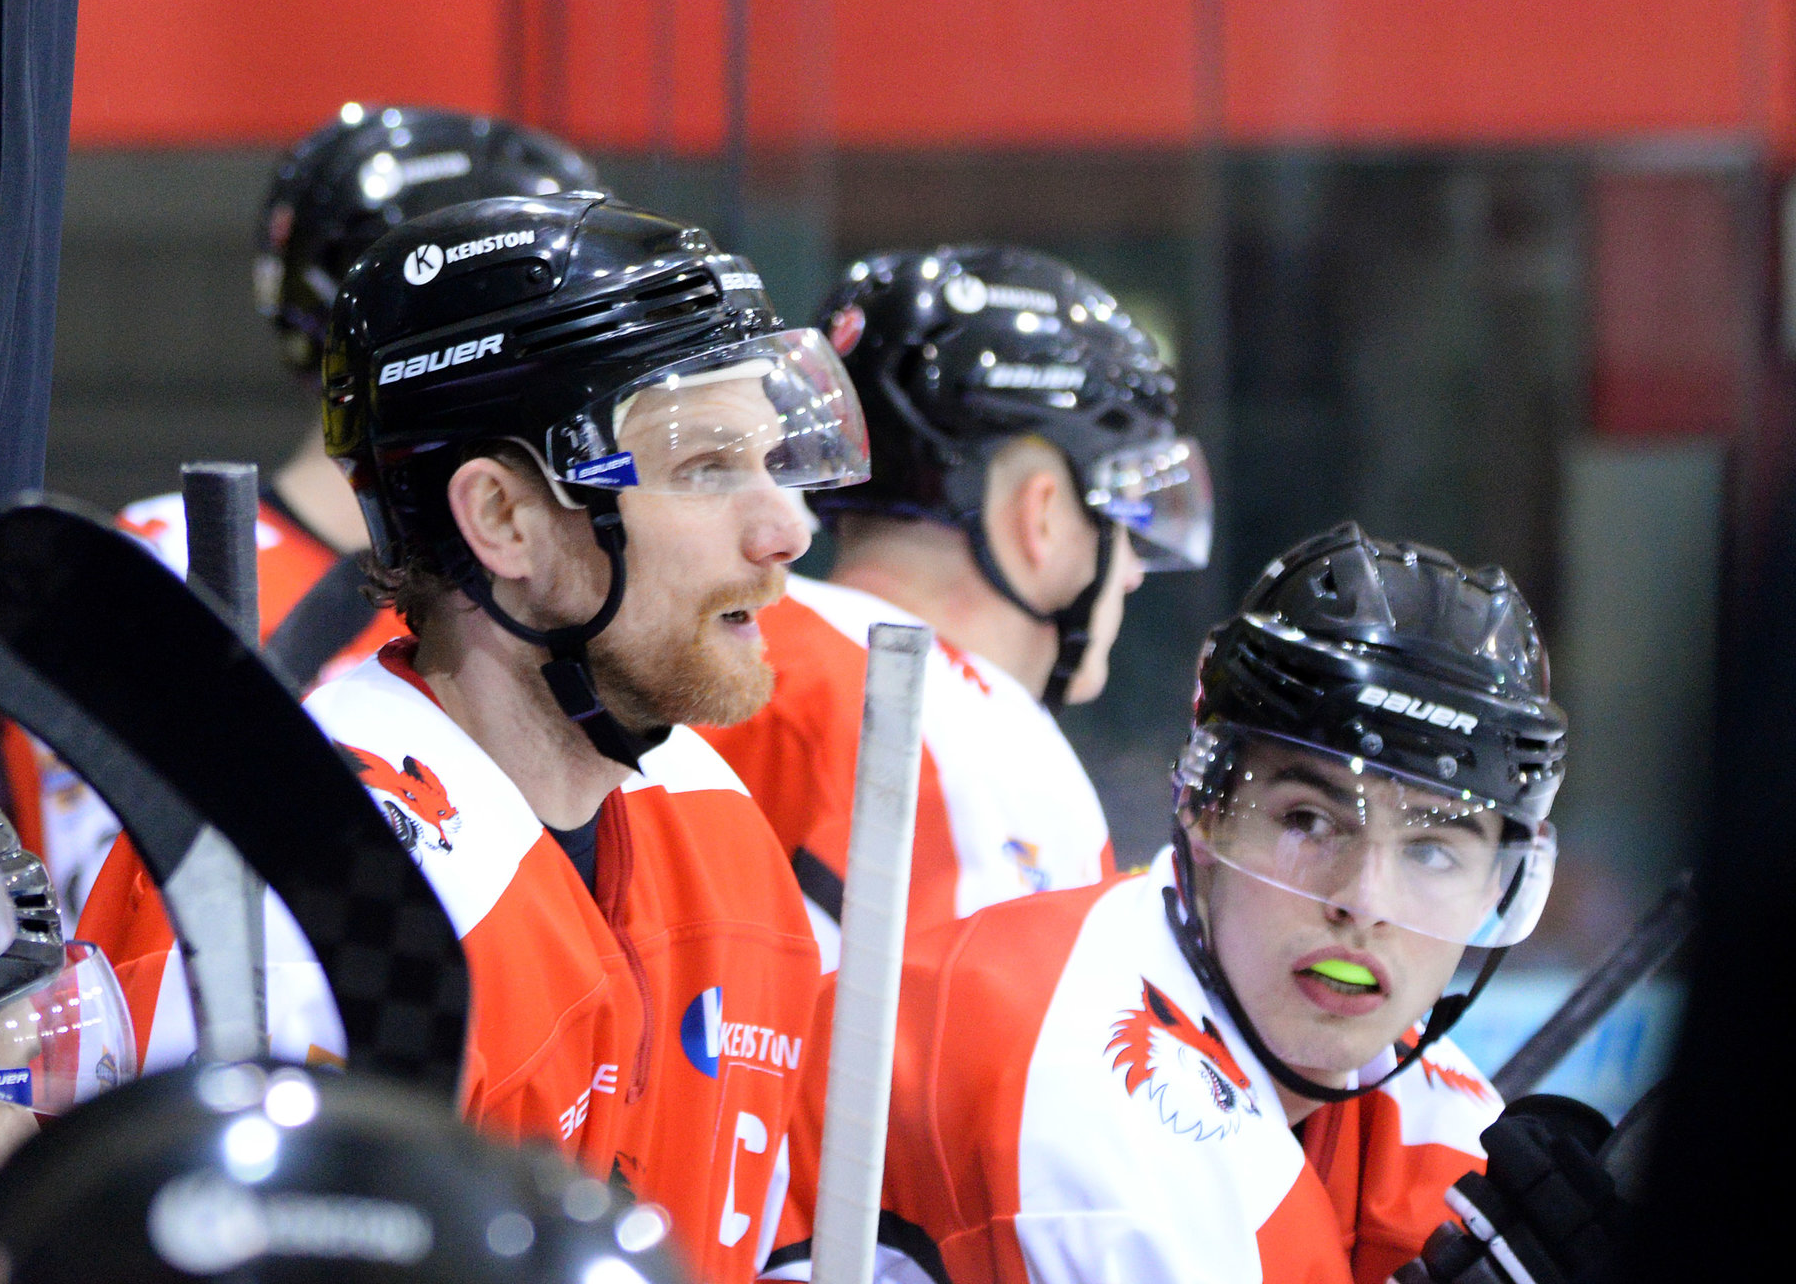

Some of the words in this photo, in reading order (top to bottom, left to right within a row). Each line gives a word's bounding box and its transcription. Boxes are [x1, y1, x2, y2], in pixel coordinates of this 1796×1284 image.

[445, 229, 535, 264] KENSTON
[378, 333, 505, 386] BAUER
[1357, 684, 1479, 736] BAUER
